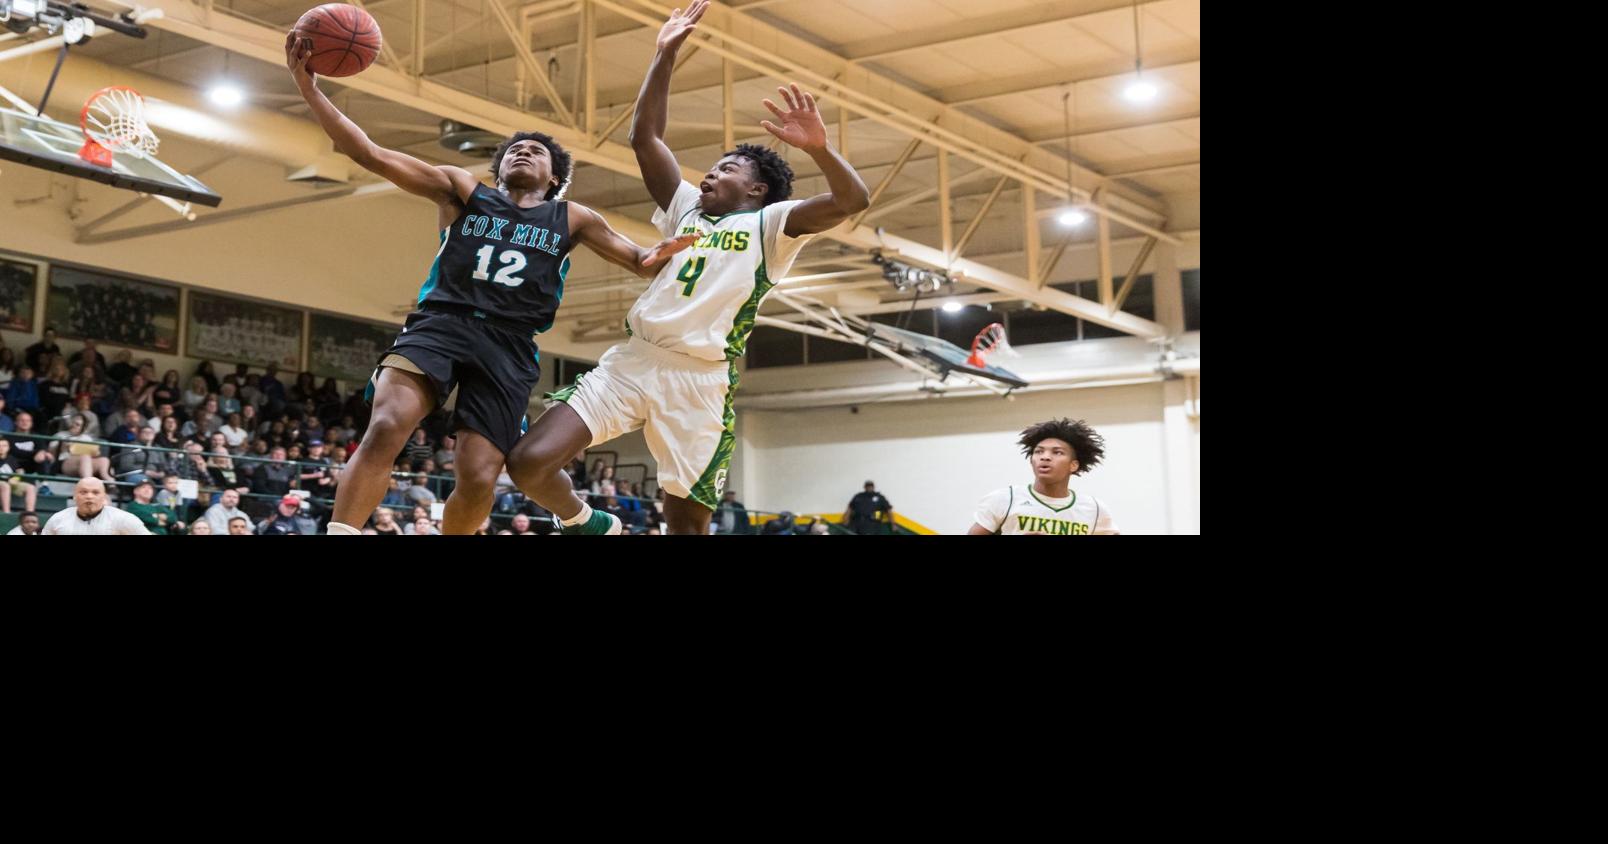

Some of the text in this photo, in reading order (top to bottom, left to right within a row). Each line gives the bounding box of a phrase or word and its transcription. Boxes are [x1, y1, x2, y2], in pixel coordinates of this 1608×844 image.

[461, 214, 561, 256] COX MILL
[472, 244, 527, 287] 12
[676, 255, 707, 297] 4
[1017, 515, 1089, 535] VIKINGS
